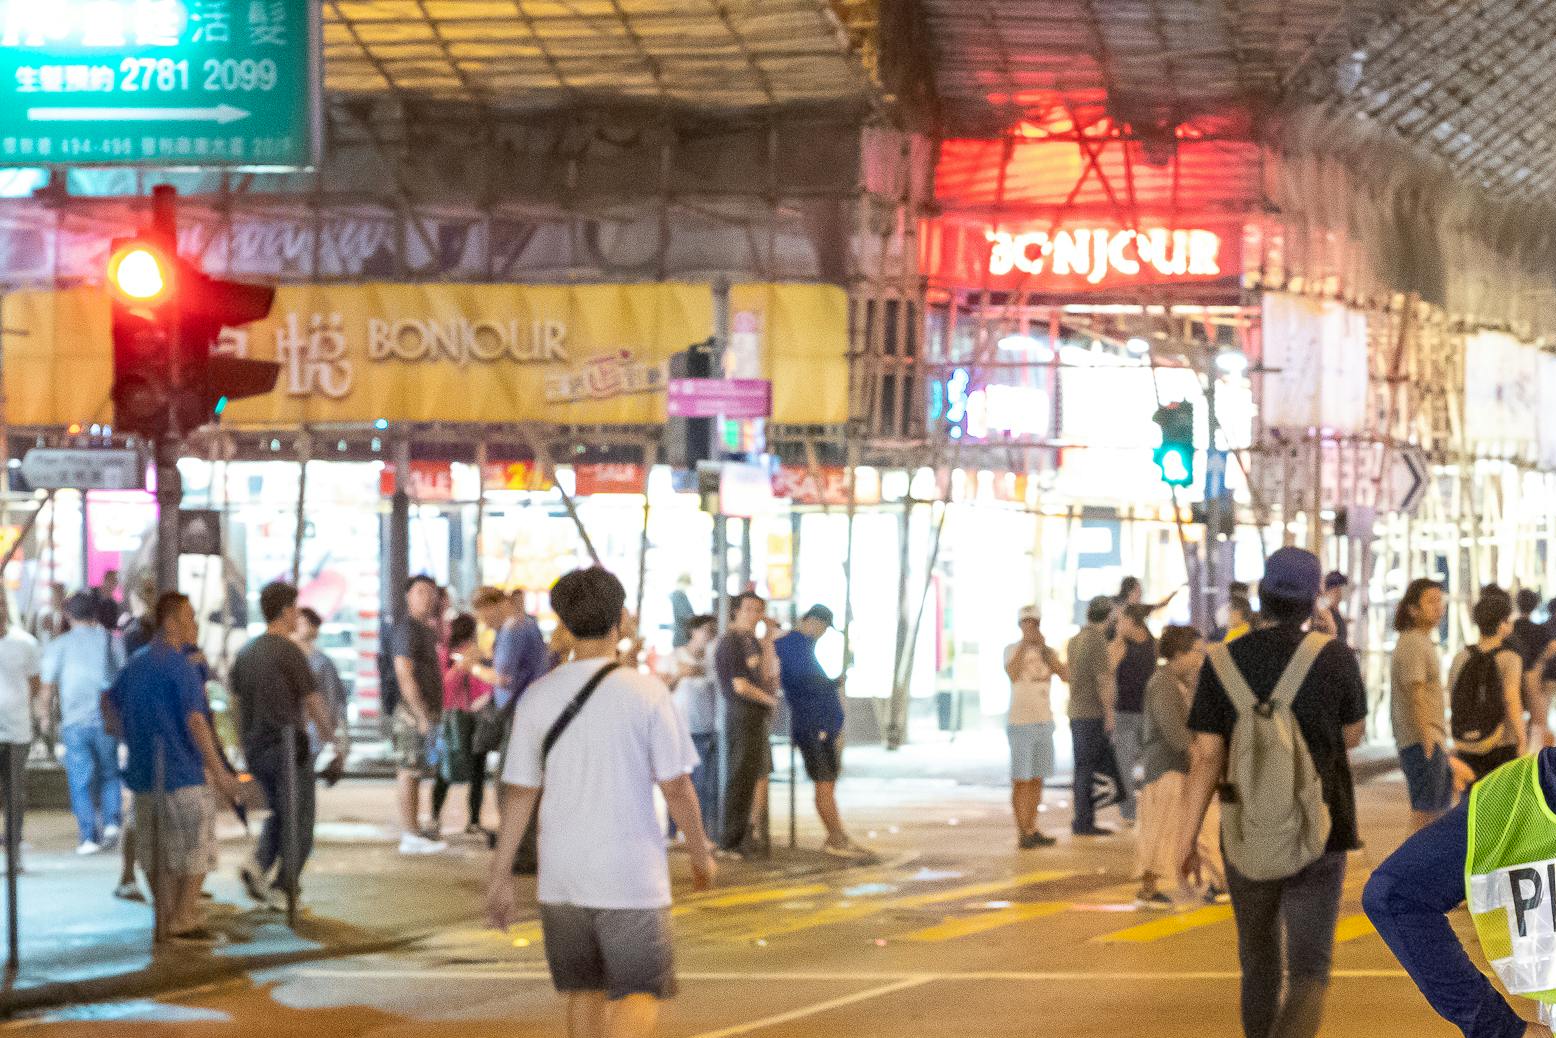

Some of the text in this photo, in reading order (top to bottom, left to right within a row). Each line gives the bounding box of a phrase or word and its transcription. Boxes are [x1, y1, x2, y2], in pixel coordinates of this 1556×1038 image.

[119, 57, 190, 91] 2781
[202, 58, 278, 92] 2099
[985, 227, 1220, 283] BONJOUR
[368, 318, 568, 366] BONJOUR
